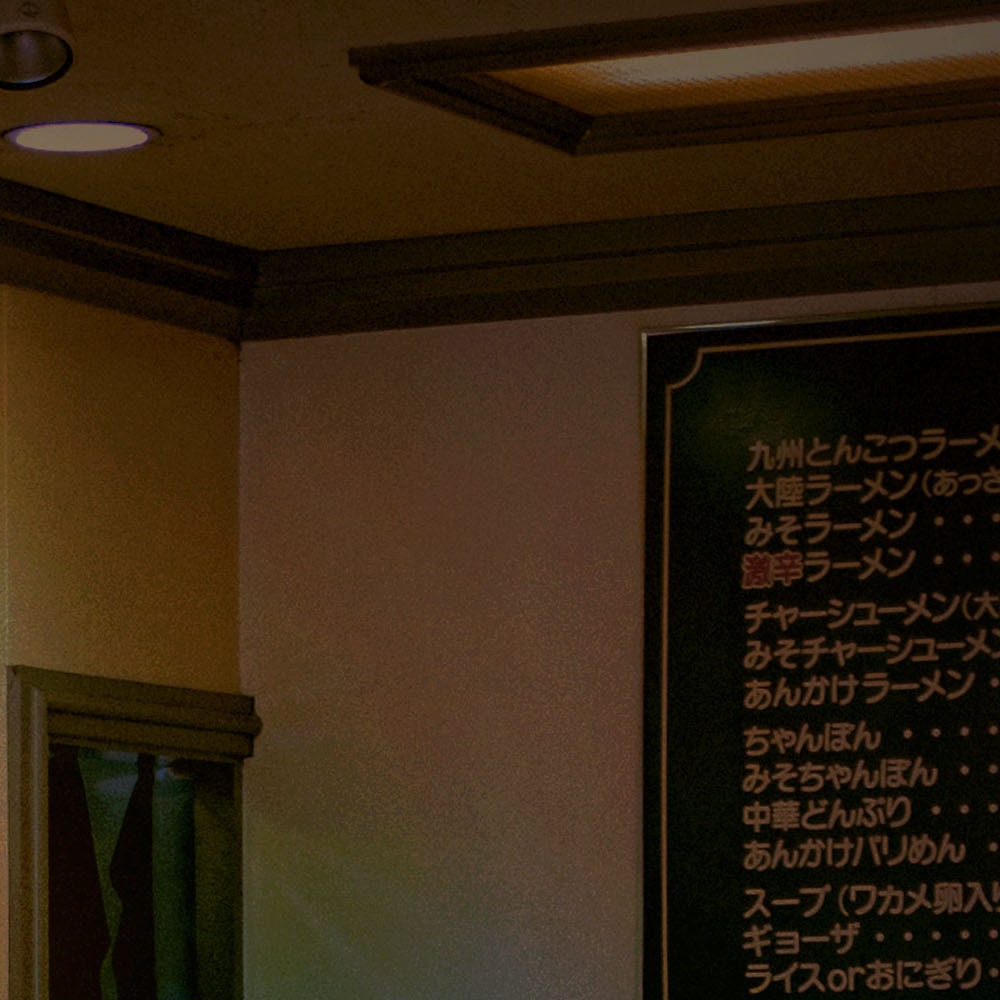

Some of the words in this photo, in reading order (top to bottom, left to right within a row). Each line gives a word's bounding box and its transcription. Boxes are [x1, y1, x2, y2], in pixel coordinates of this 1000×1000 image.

[744, 509, 917, 547] みそラーメン
[743, 669, 976, 710] あんかけラーメン
[743, 720, 882, 757] ちゃんぽん
[742, 756, 939, 795] みそちゃんぽん
[741, 795, 913, 833] 中華どんぶり
[742, 922, 861, 958] ギョーザ
